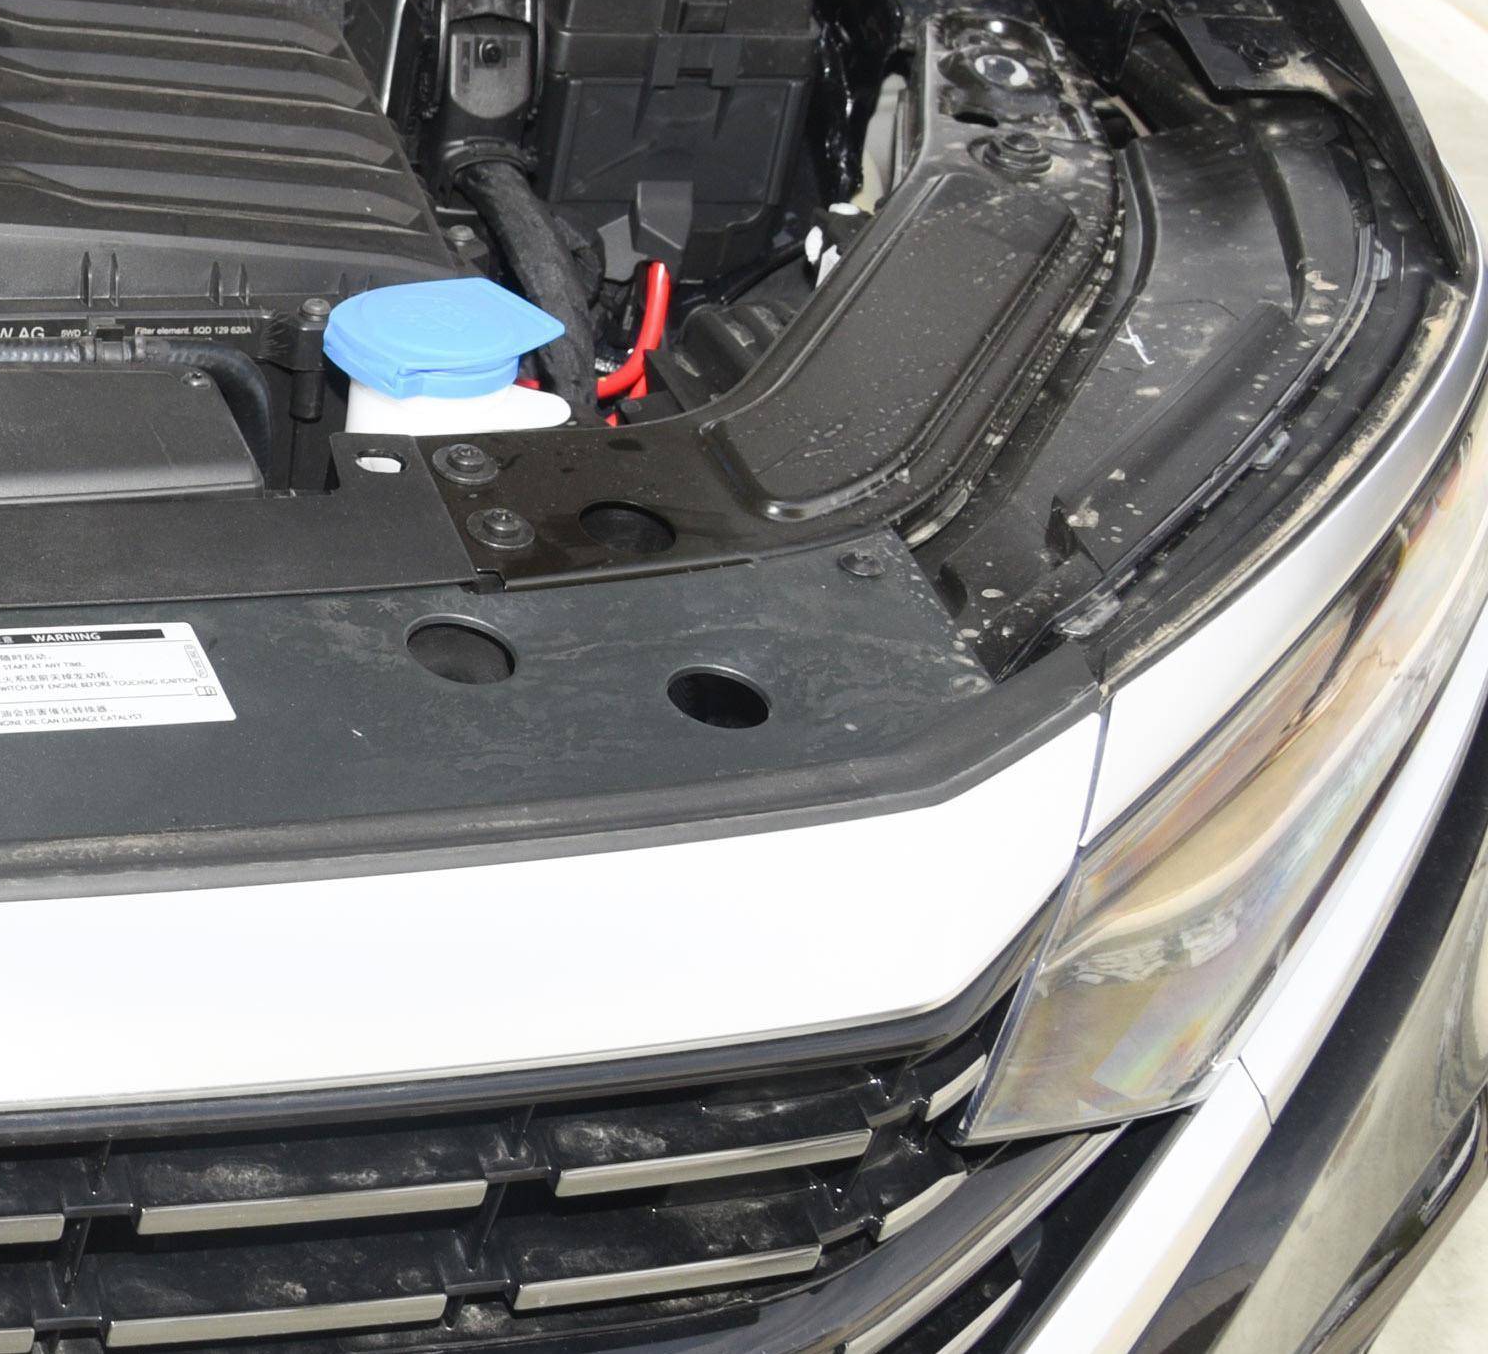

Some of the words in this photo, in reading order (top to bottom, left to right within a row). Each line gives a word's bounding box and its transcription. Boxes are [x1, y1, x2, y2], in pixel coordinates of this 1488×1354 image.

[19, 326, 44, 338] AG
[32, 632, 101, 643] WARNING
[48, 682, 78, 690] ENGINE
[80, 680, 112, 688] BEFORE
[114, 679, 158, 687] TOUCHING
[159, 677, 199, 685] IGNITION
